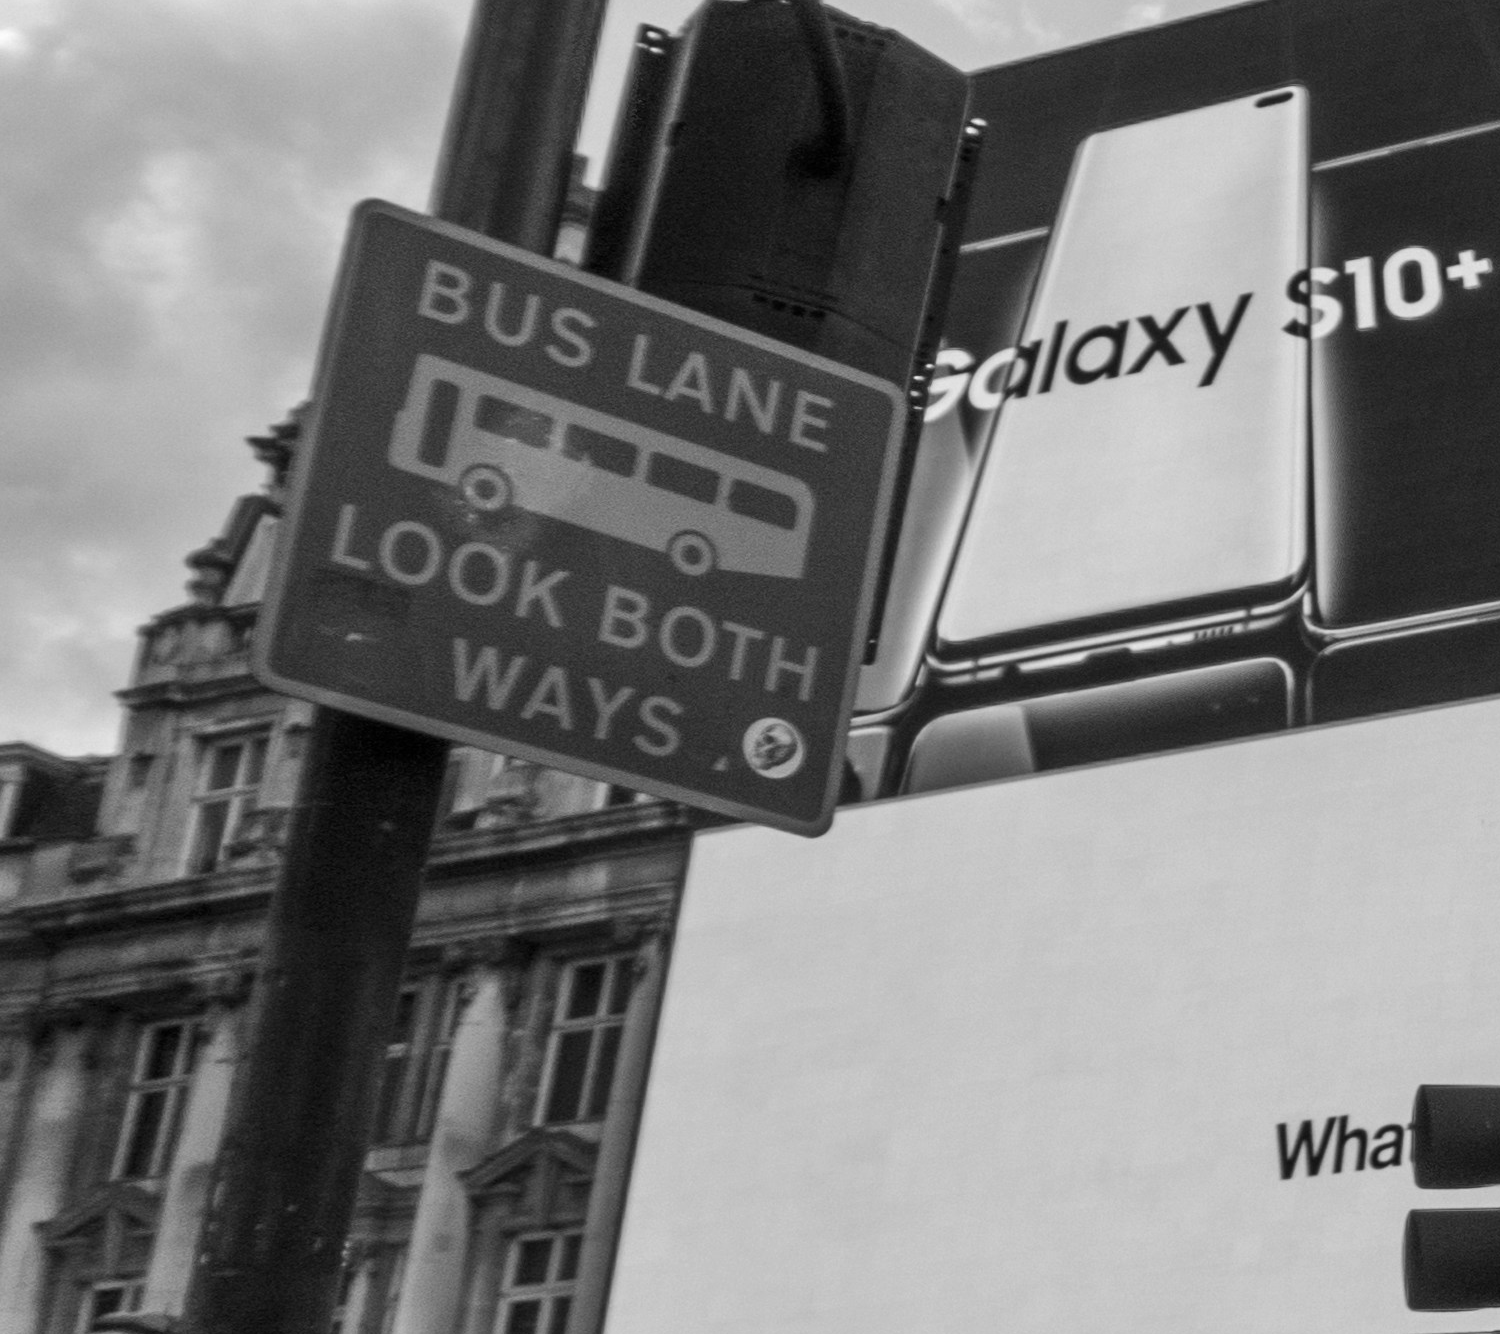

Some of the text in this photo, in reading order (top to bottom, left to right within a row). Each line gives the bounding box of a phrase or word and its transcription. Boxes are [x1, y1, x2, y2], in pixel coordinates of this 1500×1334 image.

[417, 259, 836, 454] BUS LANE
[924, 246, 1492, 421] Galaxy S10+
[329, 504, 819, 703] LOOK BOTH
[452, 638, 684, 758] WAYS
[1276, 1114, 1415, 1181] Wha
